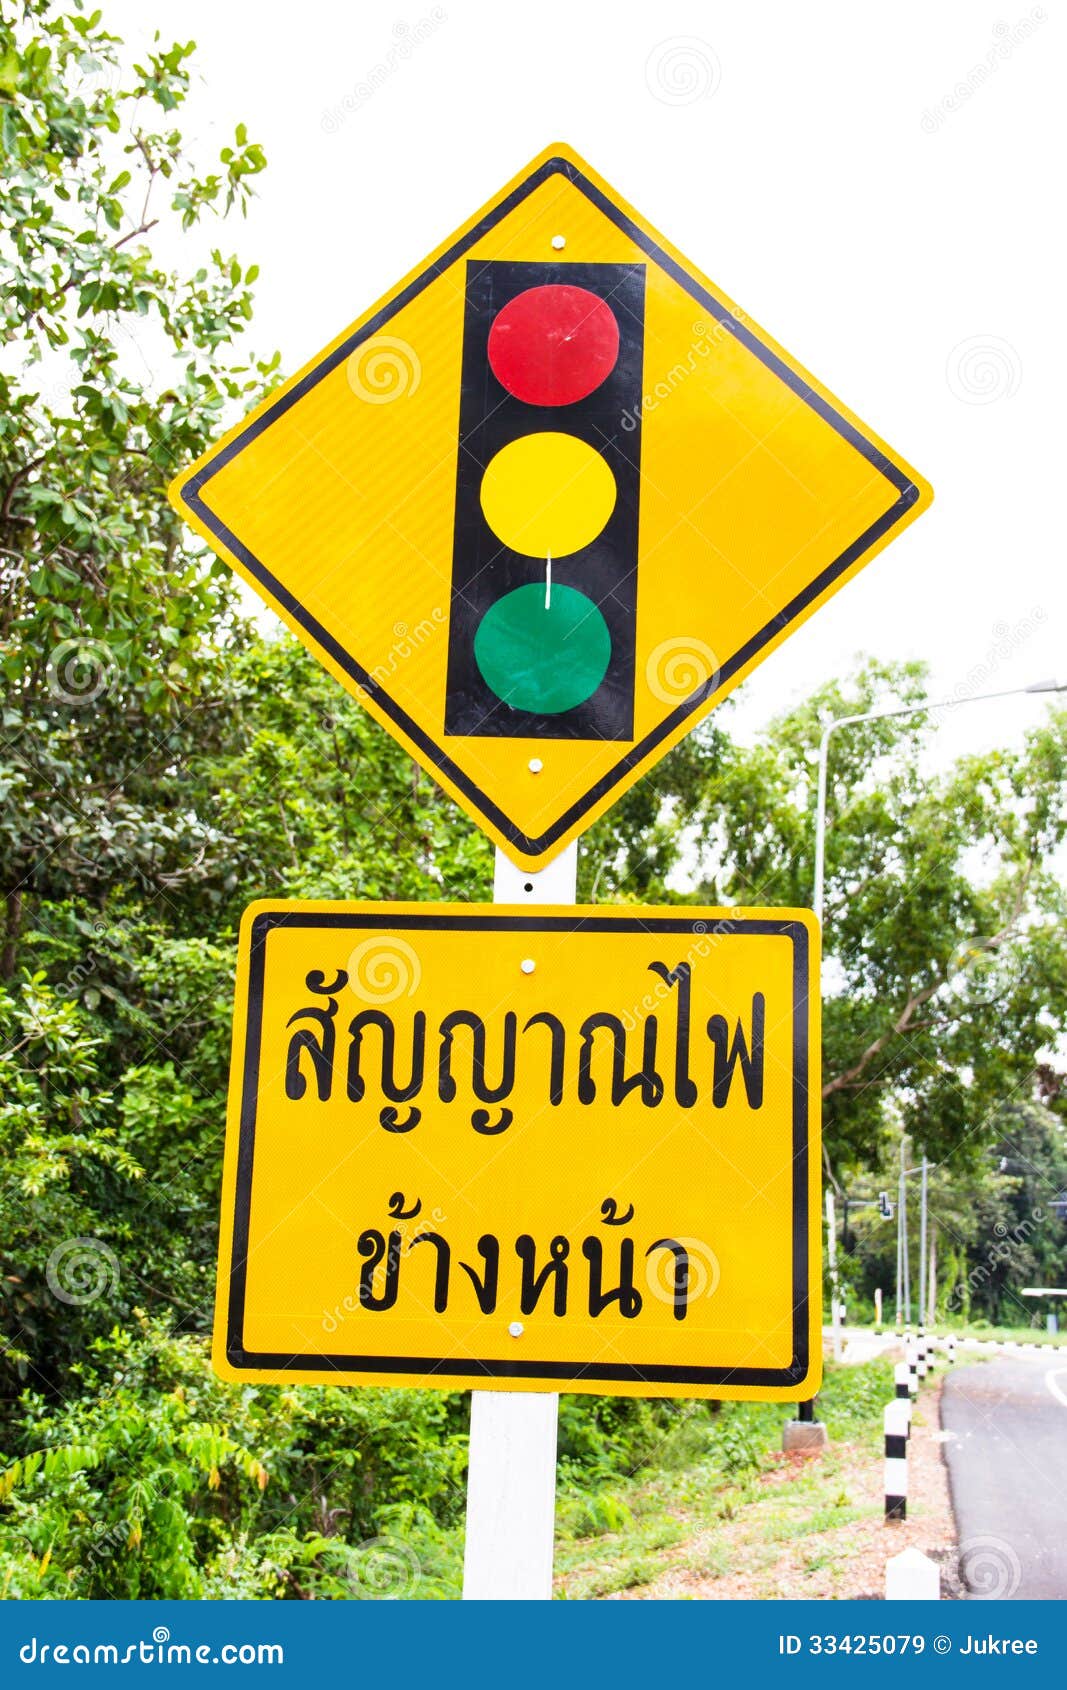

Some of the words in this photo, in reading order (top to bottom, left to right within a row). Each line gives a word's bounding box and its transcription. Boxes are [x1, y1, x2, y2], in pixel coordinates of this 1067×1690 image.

[285, 961, 766, 1135] สัญญาณไฟ
[356, 1191, 689, 1321] ข้างหน้า
